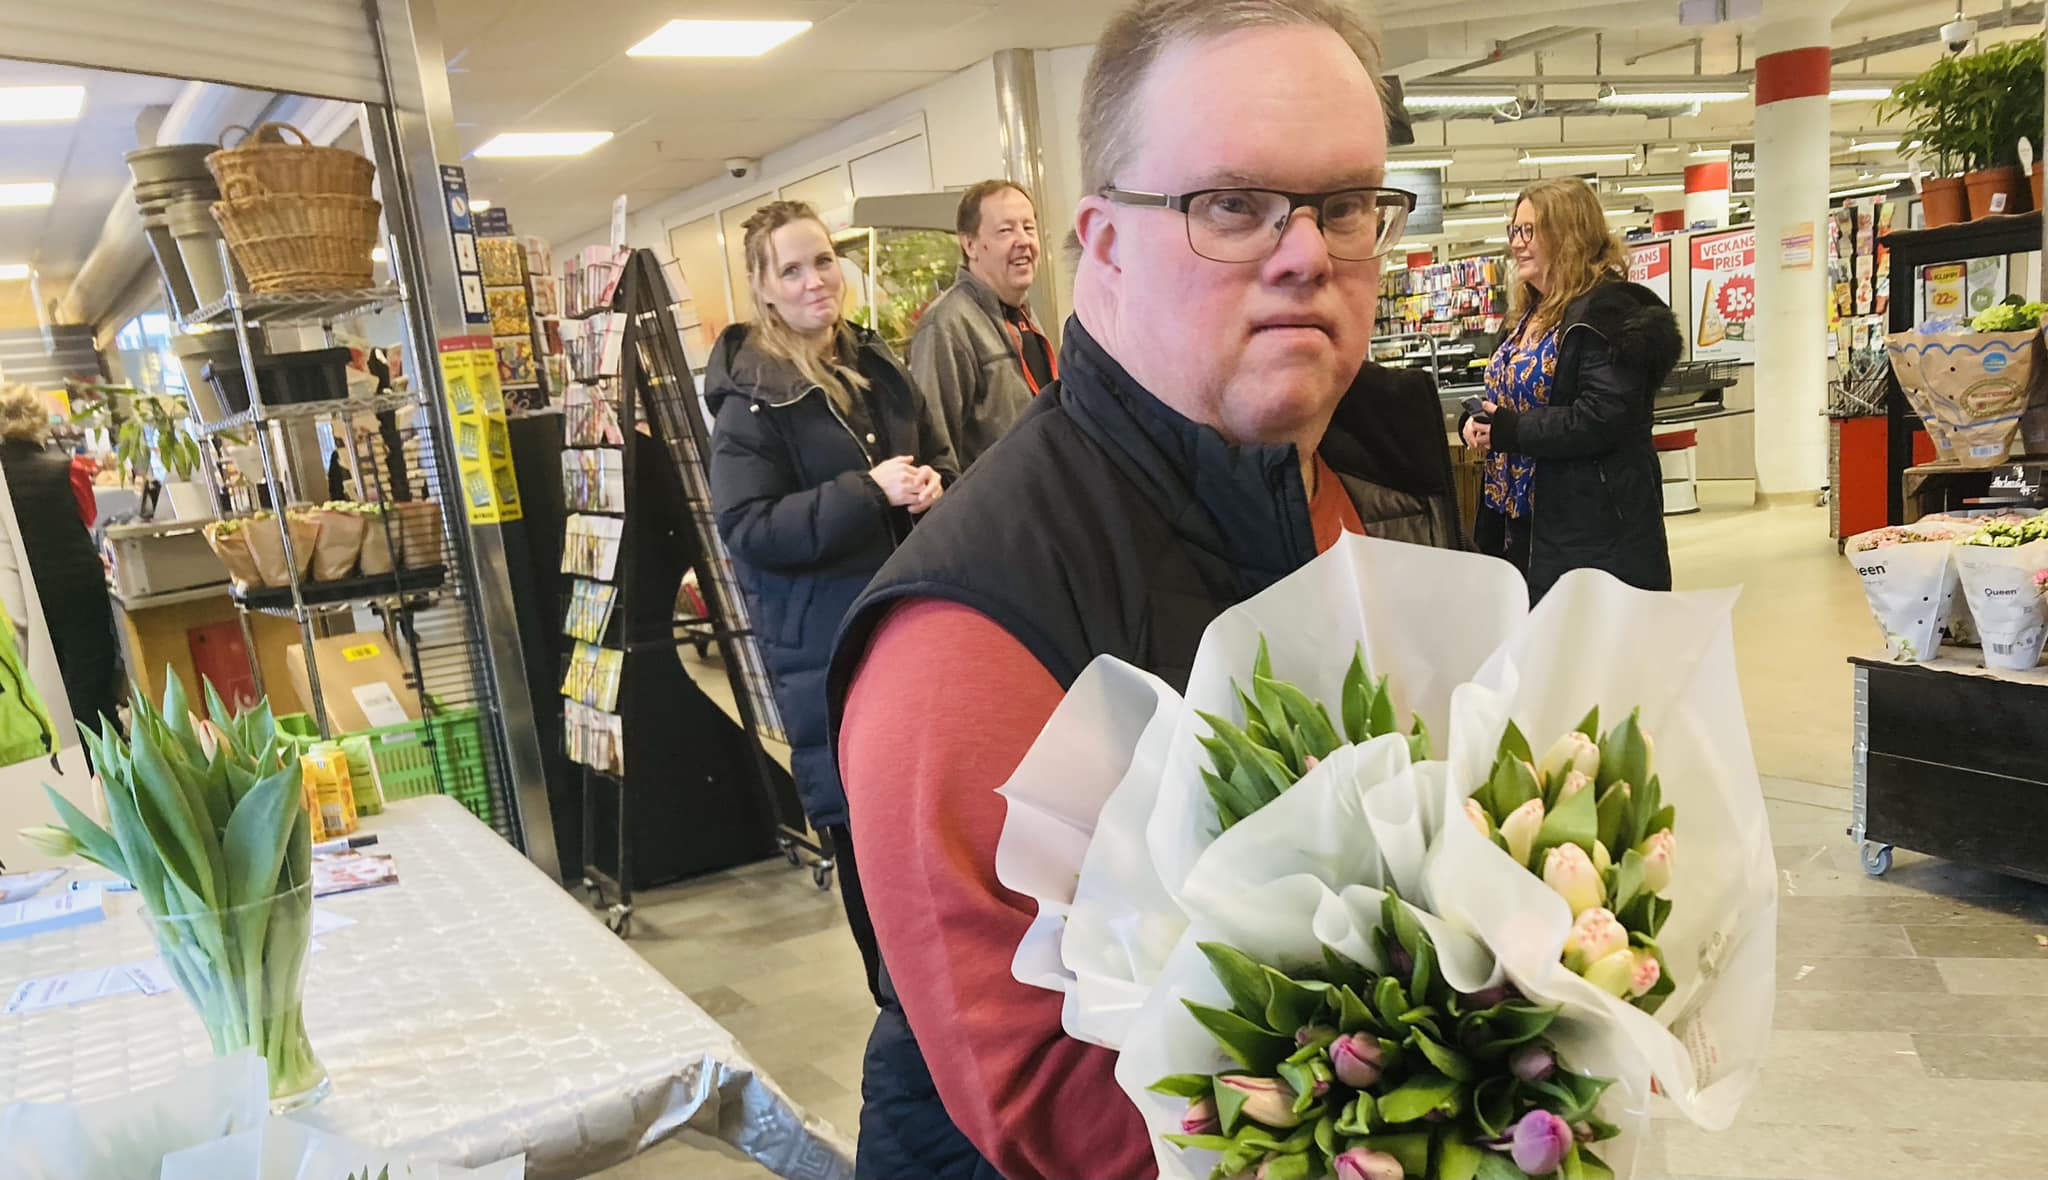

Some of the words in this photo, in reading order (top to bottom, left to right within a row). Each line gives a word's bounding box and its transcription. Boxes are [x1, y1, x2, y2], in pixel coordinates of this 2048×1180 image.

[1703, 235, 1755, 257] VECKANS
[1715, 255, 1741, 270] PRIS
[1629, 268, 1646, 281] RIS
[1726, 287, 1756, 312] 35:
[1856, 565, 1886, 577] een
[1984, 588, 2017, 597] Queen
